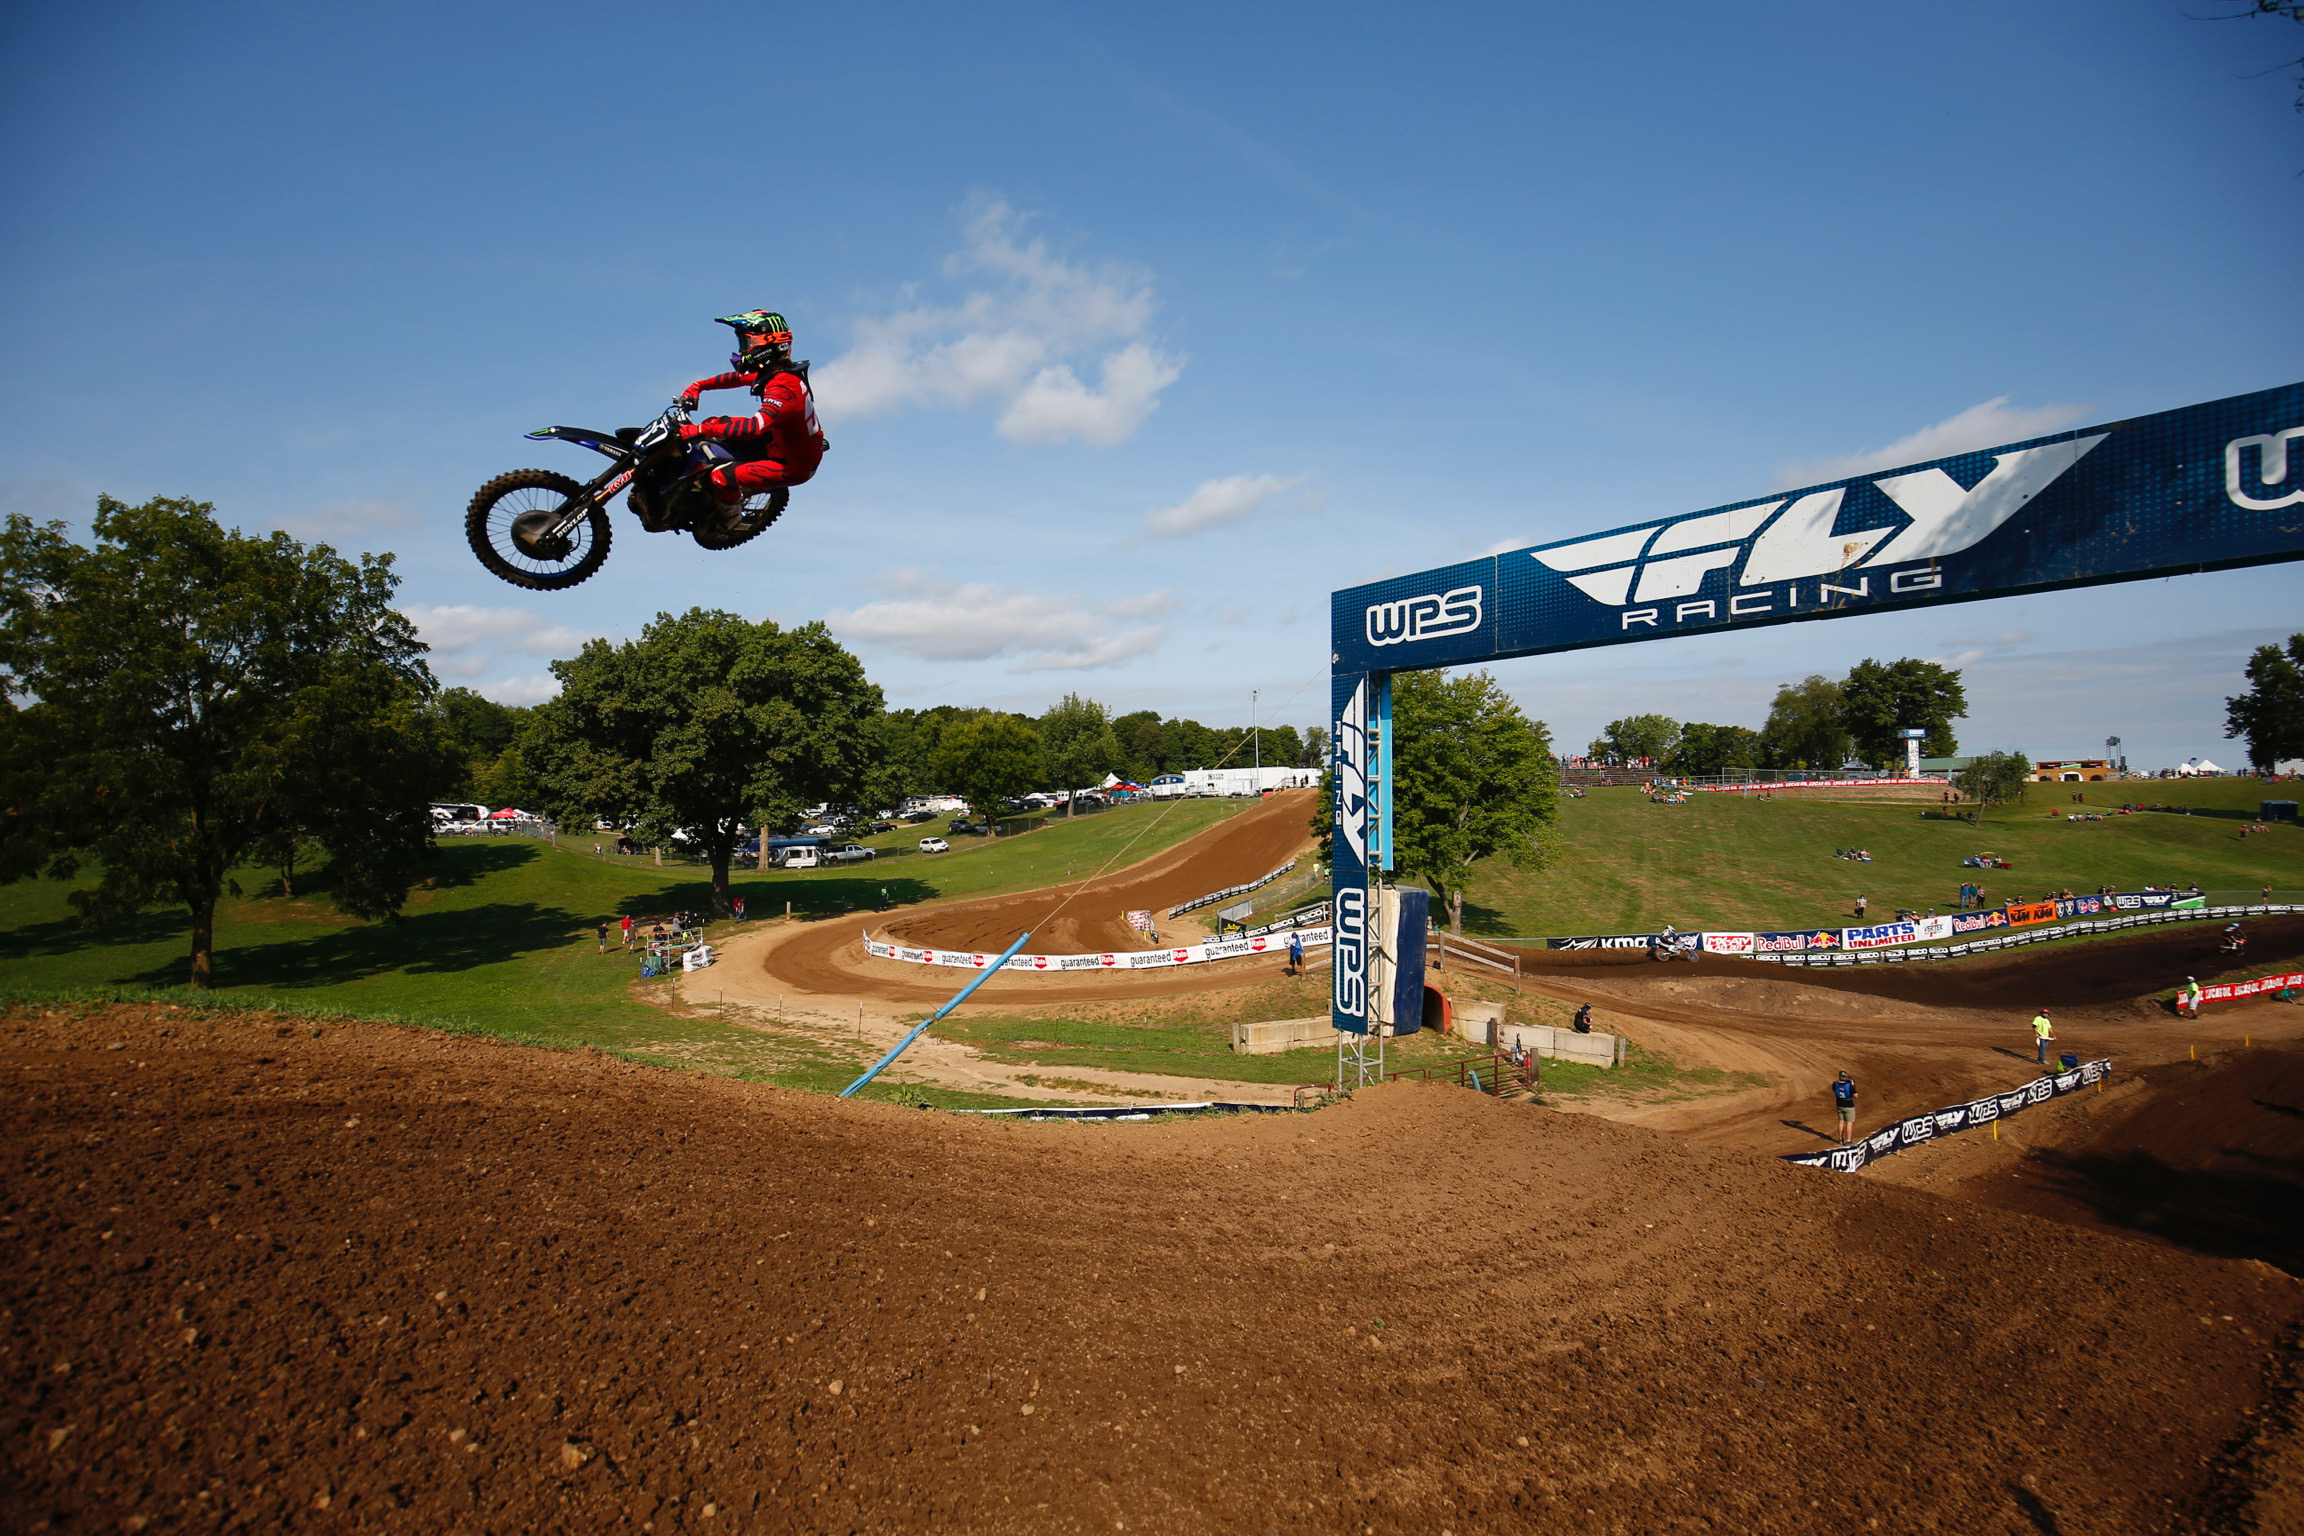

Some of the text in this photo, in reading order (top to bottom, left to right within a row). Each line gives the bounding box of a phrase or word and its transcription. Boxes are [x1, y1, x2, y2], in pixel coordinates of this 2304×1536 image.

[608, 470, 633, 494] KYB
[556, 507, 588, 539] DUNLOP
[1529, 432, 2112, 606] FLY
[1621, 565, 1943, 630] RACING
[1366, 584, 1483, 647] WPS
[1334, 720, 1343, 828] RACING
[1341, 676, 1366, 867] FLY
[1269, 917, 1294, 931] GEICO
[1297, 908, 1322, 922] GEICO
[2010, 909, 2029, 923] KTM
[1847, 922, 1915, 941] PARTS
[1848, 934, 1916, 949] UNLIMITED
[1130, 950, 1188, 967] guaranteed Rate
[1205, 938, 1265, 958] guaranteed Rate
[1336, 887, 1366, 1018] WPS
[942, 954, 972, 965] guaranteed
[1061, 956, 1099, 969] guaranteed
[1935, 1109, 1966, 1127] FLY
[1869, 1127, 1900, 1150] FLY
[1901, 1115, 1934, 1144] WPS
